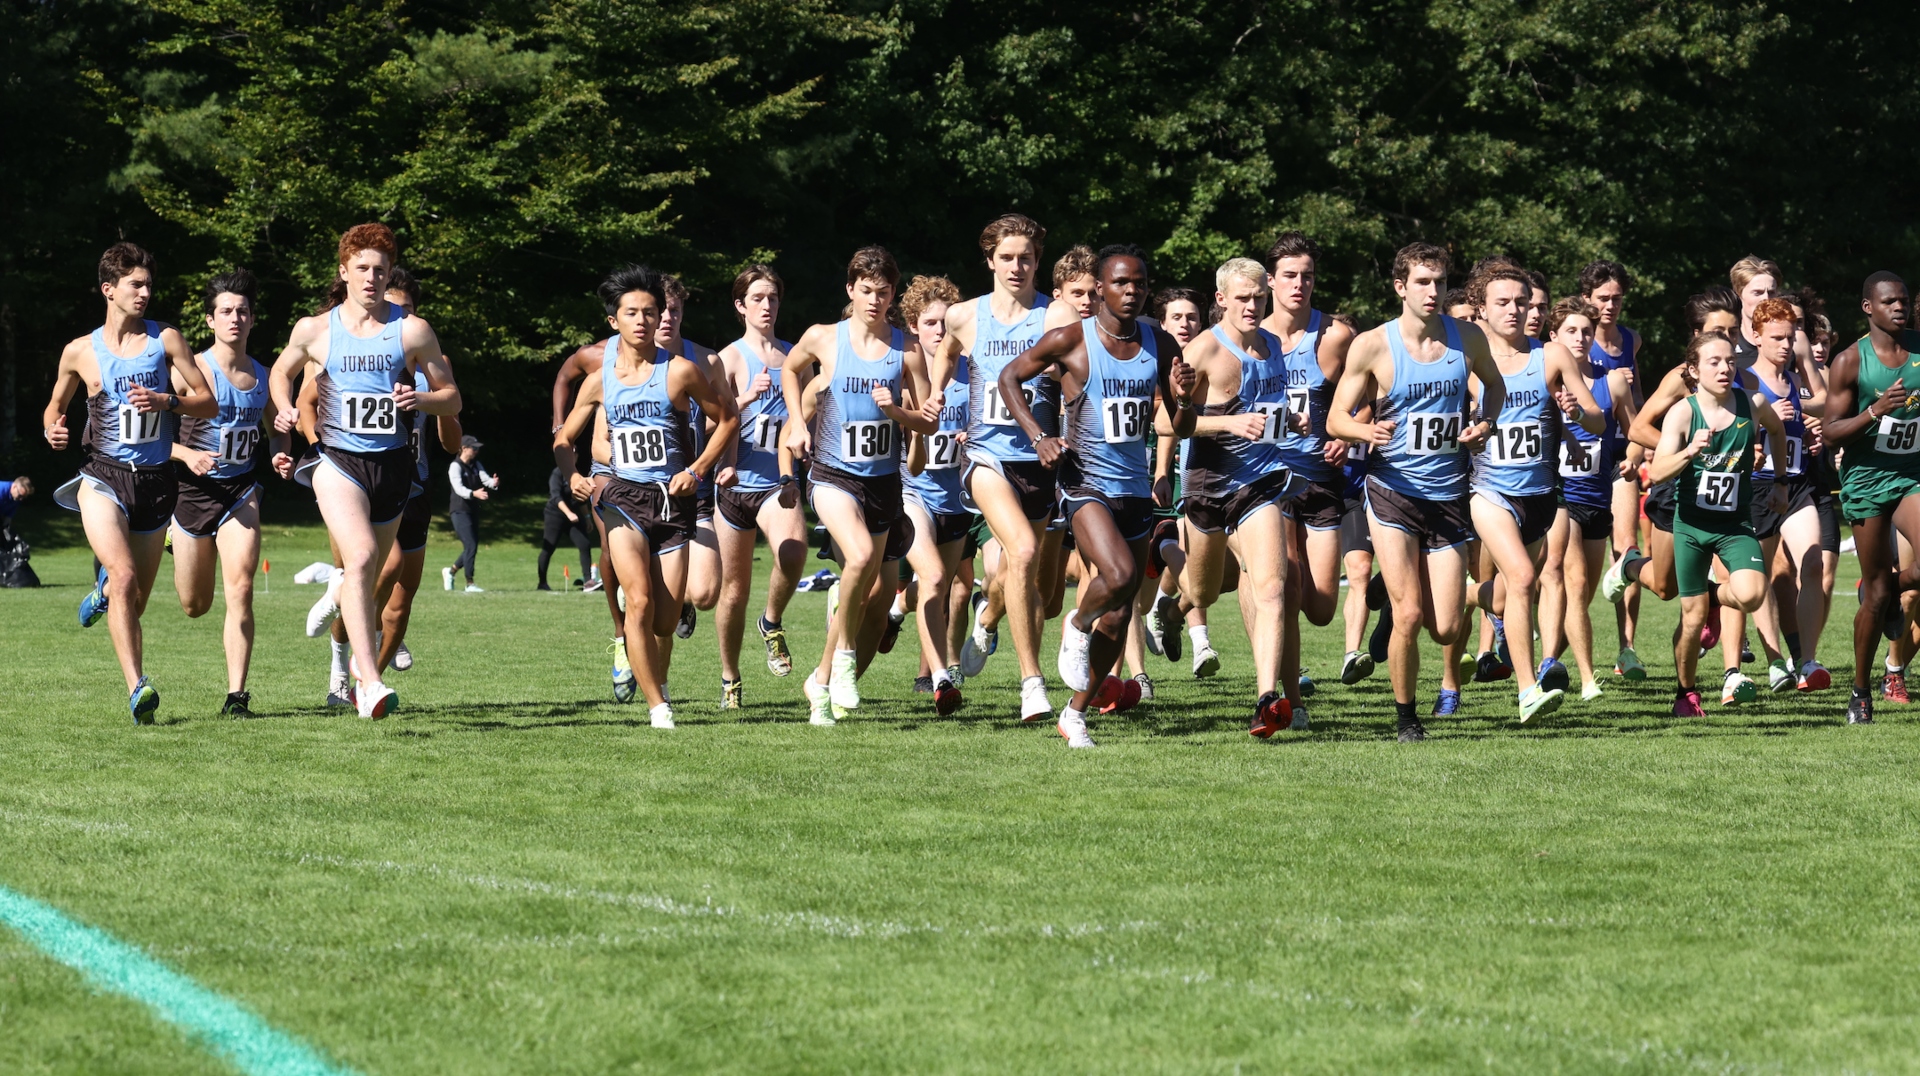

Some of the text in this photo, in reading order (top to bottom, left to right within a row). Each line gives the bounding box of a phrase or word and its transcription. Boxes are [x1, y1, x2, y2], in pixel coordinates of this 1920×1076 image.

[340, 354, 392, 373] JUMBOS
[1286, 369, 1307, 385] BOS
[1102, 378, 1151, 397] JUMBOS
[1405, 379, 1459, 401] JUMBOS
[1504, 390, 1540, 409] MBOS
[122, 409, 161, 440] 117
[223, 406, 262, 422] JUMBOS
[346, 397, 394, 430] 123
[613, 401, 662, 420] JUMBOS
[941, 405, 963, 422] BOS
[224, 429, 259, 461] 126
[617, 429, 665, 464] 138
[845, 424, 891, 458] 130
[1412, 416, 1459, 451] 134
[1497, 424, 1541, 461] 125
[1886, 421, 1918, 451] 59
[1705, 475, 1735, 507] 52
